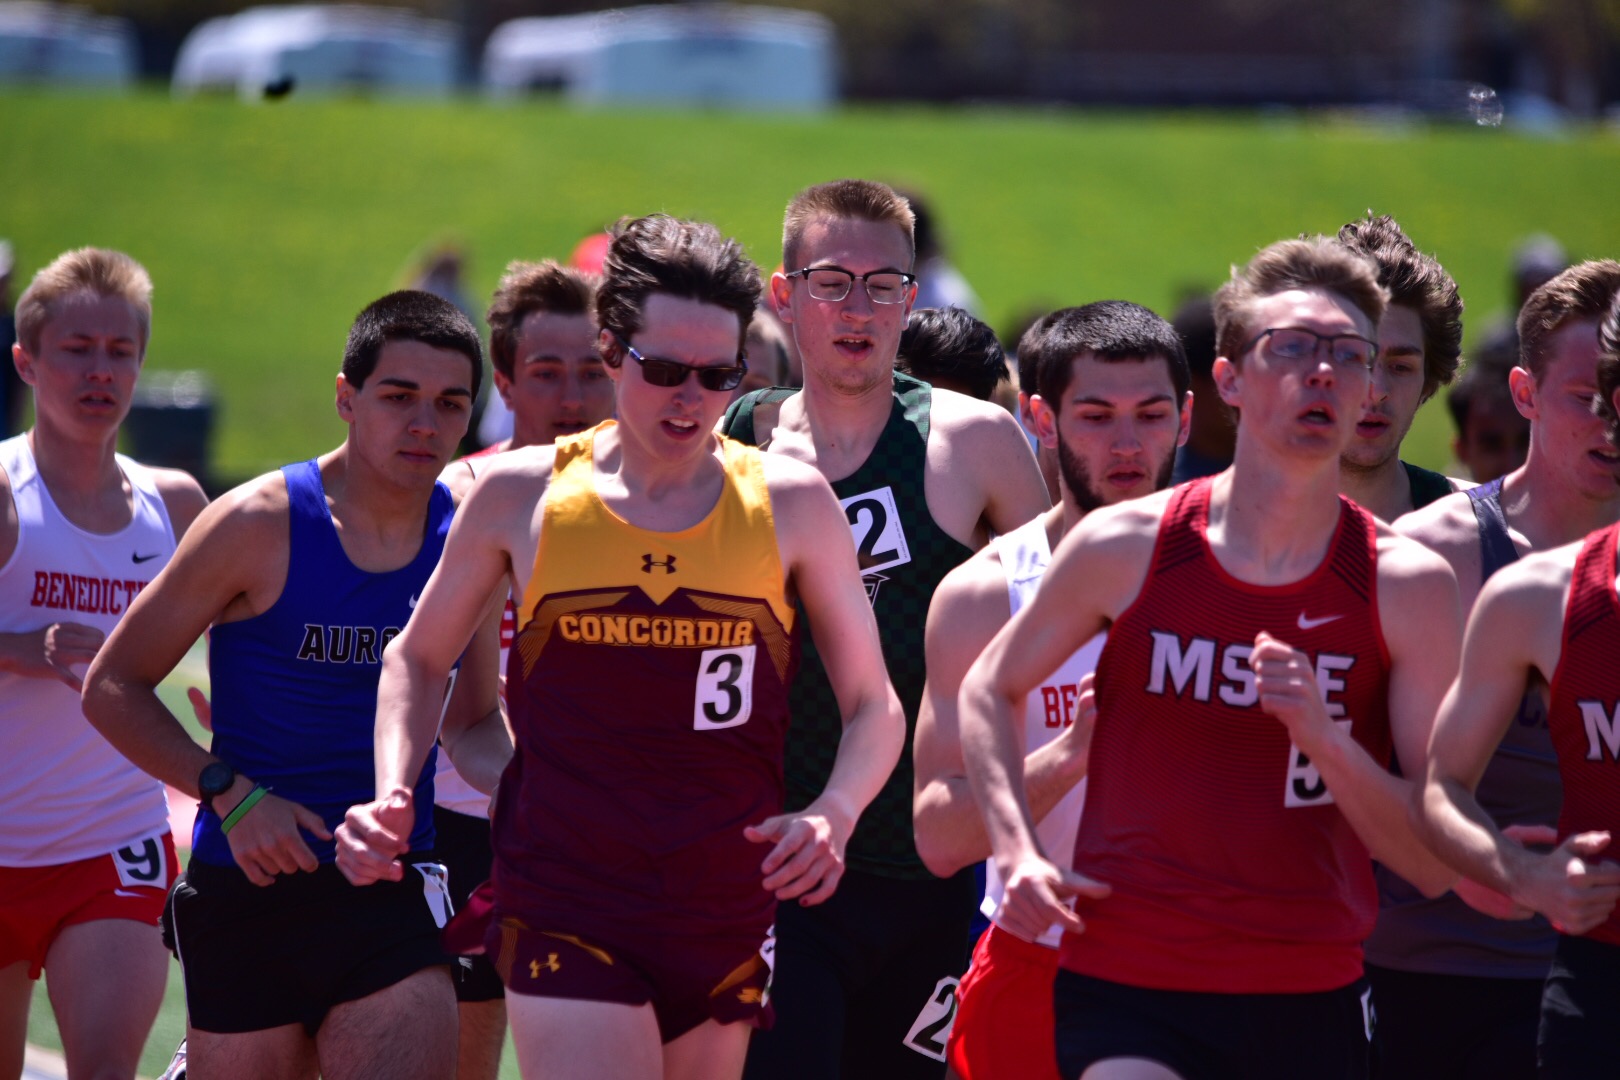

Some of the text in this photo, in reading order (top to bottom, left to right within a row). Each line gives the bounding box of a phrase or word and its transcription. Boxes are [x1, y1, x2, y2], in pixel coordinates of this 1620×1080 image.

[844, 498, 900, 571] 2
[557, 613, 755, 648] CONCORDIA
[702, 653, 743, 724] 3
[1146, 631, 1356, 717] MSE
[117, 838, 161, 882] 9
[910, 983, 957, 1056] 2
